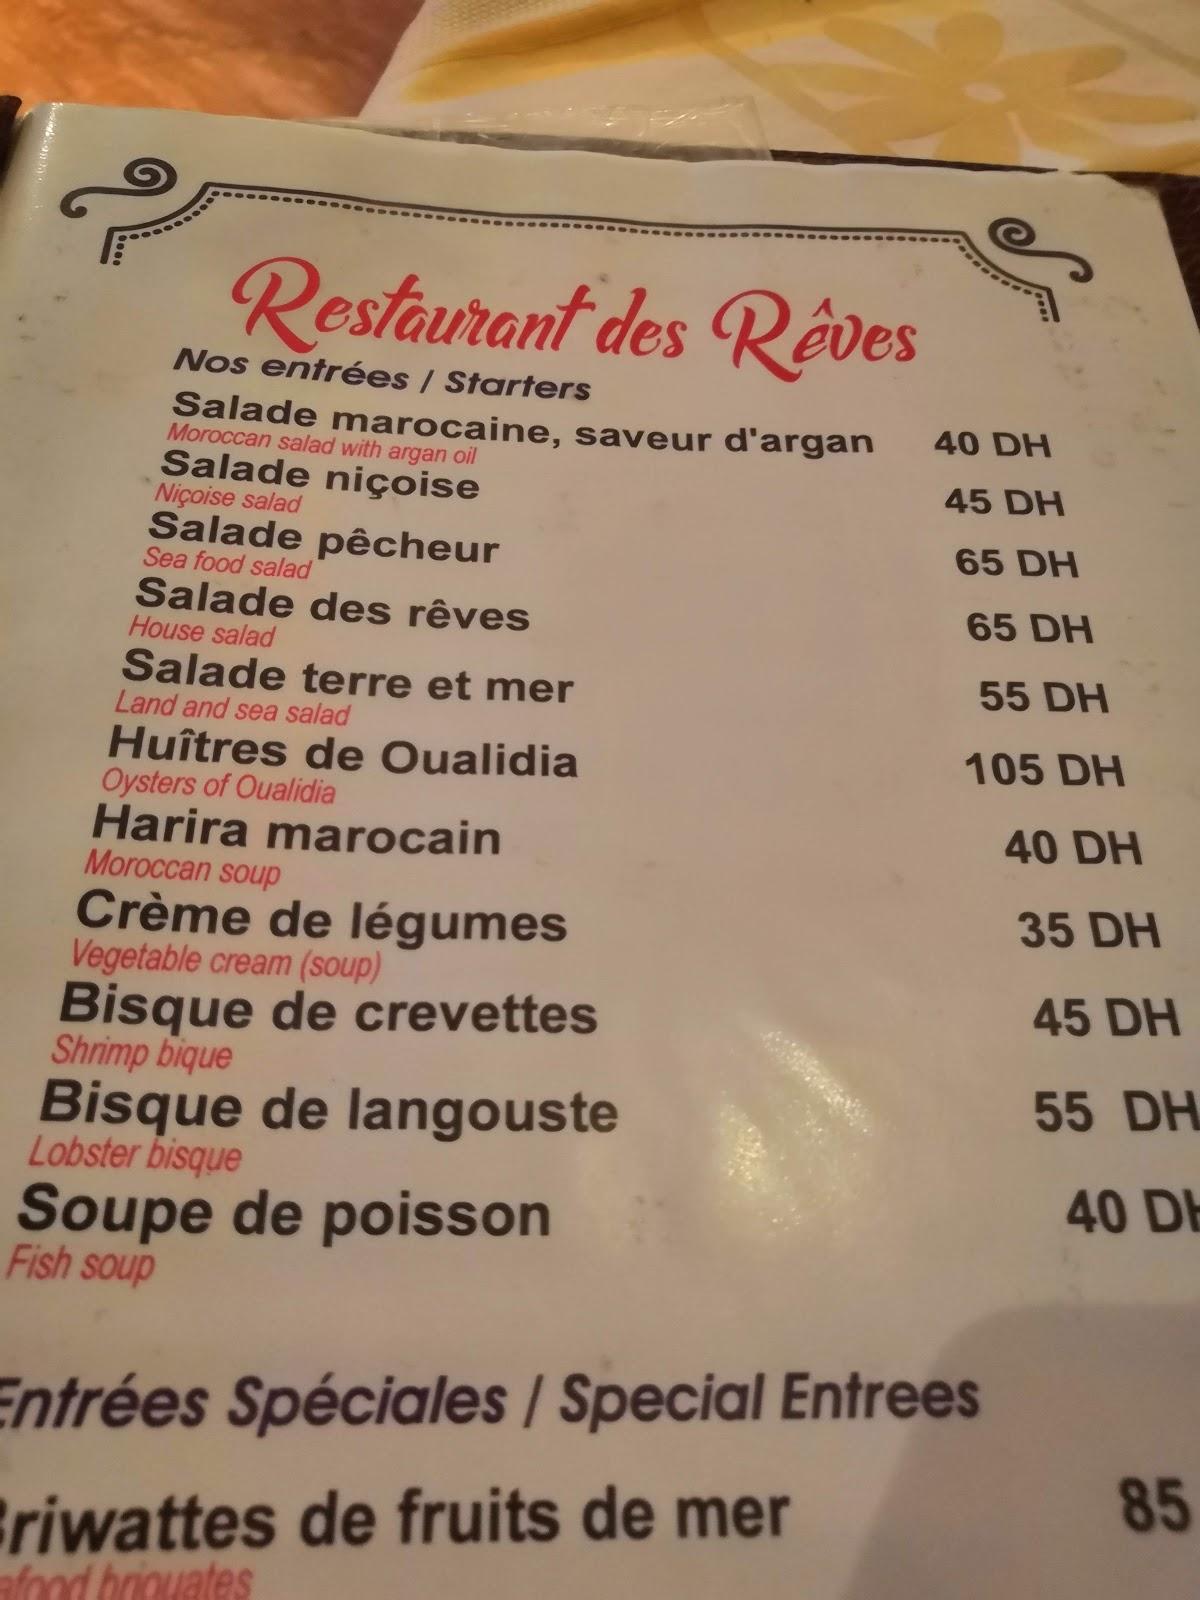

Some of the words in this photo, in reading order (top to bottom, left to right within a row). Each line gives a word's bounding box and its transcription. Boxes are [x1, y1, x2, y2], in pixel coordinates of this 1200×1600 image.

[232, 256, 597, 354] Restaurant
[596, 287, 687, 358] des
[712, 289, 917, 383] Rêves
[173, 348, 249, 374] Nos
[261, 359, 409, 390] entrées
[420, 369, 434, 393] /
[445, 371, 591, 401] Starters
[167, 423, 272, 448] Moroccan
[277, 435, 336, 455] salad
[341, 440, 382, 458] with
[387, 445, 447, 466] argan
[452, 448, 477, 465] oil
[172, 391, 317, 427] Salade
[332, 412, 560, 449] marocaine,
[575, 427, 712, 451] saveur
[725, 428, 873, 459] d'argan
[934, 431, 979, 456] 40
[992, 432, 1051, 458] DH
[161, 450, 310, 487] Salade
[326, 466, 479, 500] niçoise
[155, 483, 236, 509] Niçoise
[241, 491, 302, 514] salad
[945, 488, 992, 514] 45
[1004, 489, 1064, 516] DH
[148, 511, 302, 550] Salade
[318, 528, 500, 563] pêcheur
[143, 546, 188, 569] Sea
[193, 550, 246, 575] food
[250, 559, 313, 580] salad
[956, 548, 1004, 576] 65
[1016, 550, 1079, 578] DH
[136, 577, 294, 618] Salade
[310, 592, 391, 625] des
[409, 599, 529, 631] rêves
[128, 616, 205, 643] House
[211, 625, 277, 649] salad
[967, 612, 1017, 642] 65
[1030, 614, 1093, 643] DH
[122, 648, 285, 691] Salade
[302, 663, 412, 698] terre
[428, 671, 471, 700] et
[487, 678, 574, 703] mer
[980, 681, 1030, 711] 55
[1043, 682, 1109, 713] DH
[114, 692, 178, 717] Land
[182, 698, 230, 720] and
[234, 702, 279, 722] sea
[285, 704, 353, 727] salad
[108, 725, 287, 767] Huîtres
[306, 737, 364, 771] de
[381, 741, 578, 777] Oualidia
[966, 753, 1044, 785] 105
[1057, 754, 1125, 787] DH
[101, 767, 197, 799] Oysters
[203, 772, 232, 798] of
[235, 773, 337, 805] Oualidia
[92, 803, 247, 847] Harira
[267, 820, 500, 855] marocain
[1005, 830, 1058, 864] 40
[1072, 830, 1142, 865] DH
[84, 847, 212, 881] Moroccan
[218, 862, 282, 892] soup
[77, 888, 251, 935] Crème
[270, 900, 332, 939] de
[351, 902, 567, 950] légumes
[1018, 912, 1074, 948] 35
[1089, 912, 1161, 948] DH
[72, 940, 202, 977] Vegetable
[209, 952, 293, 976] cream
[299, 952, 381, 983] (soup)
[60, 981, 253, 1037] Bisque
[272, 990, 336, 1031] de
[355, 994, 597, 1034] crevettes
[1033, 998, 1091, 1037] 45
[1105, 998, 1181, 1036] DH
[51, 1033, 150, 1073] Shrimp
[156, 1039, 233, 1074] bique
[40, 1078, 242, 1136] Bisque
[262, 1087, 328, 1130] de
[349, 1087, 618, 1142] langouste
[1035, 1091, 1093, 1132] 55
[1123, 1090, 1200, 1131] DH
[27, 1136, 141, 1169] Lobster
[146, 1138, 242, 1176] bisque
[17, 1182, 213, 1245] Soupe
[233, 1189, 303, 1236] de
[322, 1190, 549, 1248] poisson
[1066, 1189, 1127, 1234] 40
[6, 1244, 72, 1281] Fish
[79, 1253, 155, 1286] soup
[228, 1372, 508, 1438] Spéciales
[523, 1374, 544, 1428] /
[560, 1373, 765, 1434] Special
[781, 1372, 980, 1420] Entrees
[0, 1494, 276, 1555] riwattes
[300, 1489, 376, 1547] de
[397, 1487, 560, 1544] fruits
[582, 1484, 655, 1541] de
[677, 1495, 790, 1539] mer
[1119, 1477, 1191, 1533] 85
